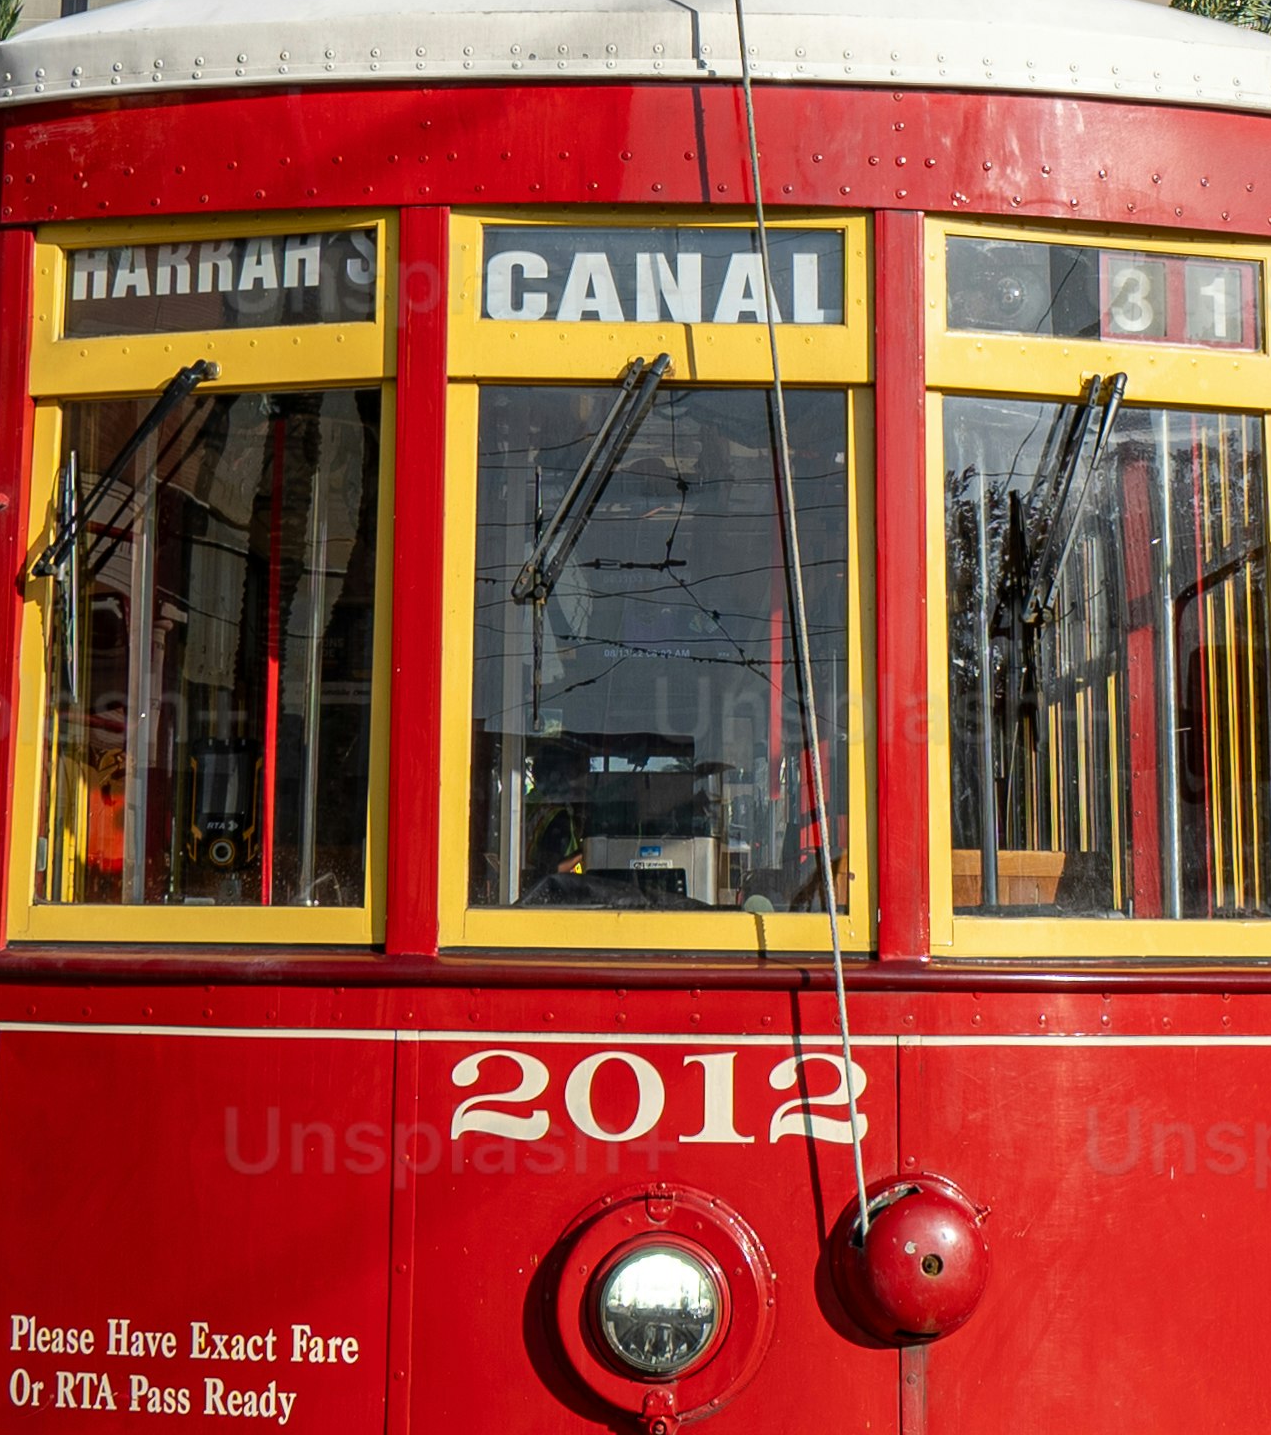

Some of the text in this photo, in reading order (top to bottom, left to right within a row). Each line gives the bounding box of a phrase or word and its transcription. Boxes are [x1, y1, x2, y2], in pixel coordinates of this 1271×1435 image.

[486, 250, 825, 324] CANAL
[451, 1049, 868, 1144] 2012
[10, 1314, 359, 1363] Please Have Exact Fare
[9, 1368, 296, 1425] Or RTA Pass Ready
